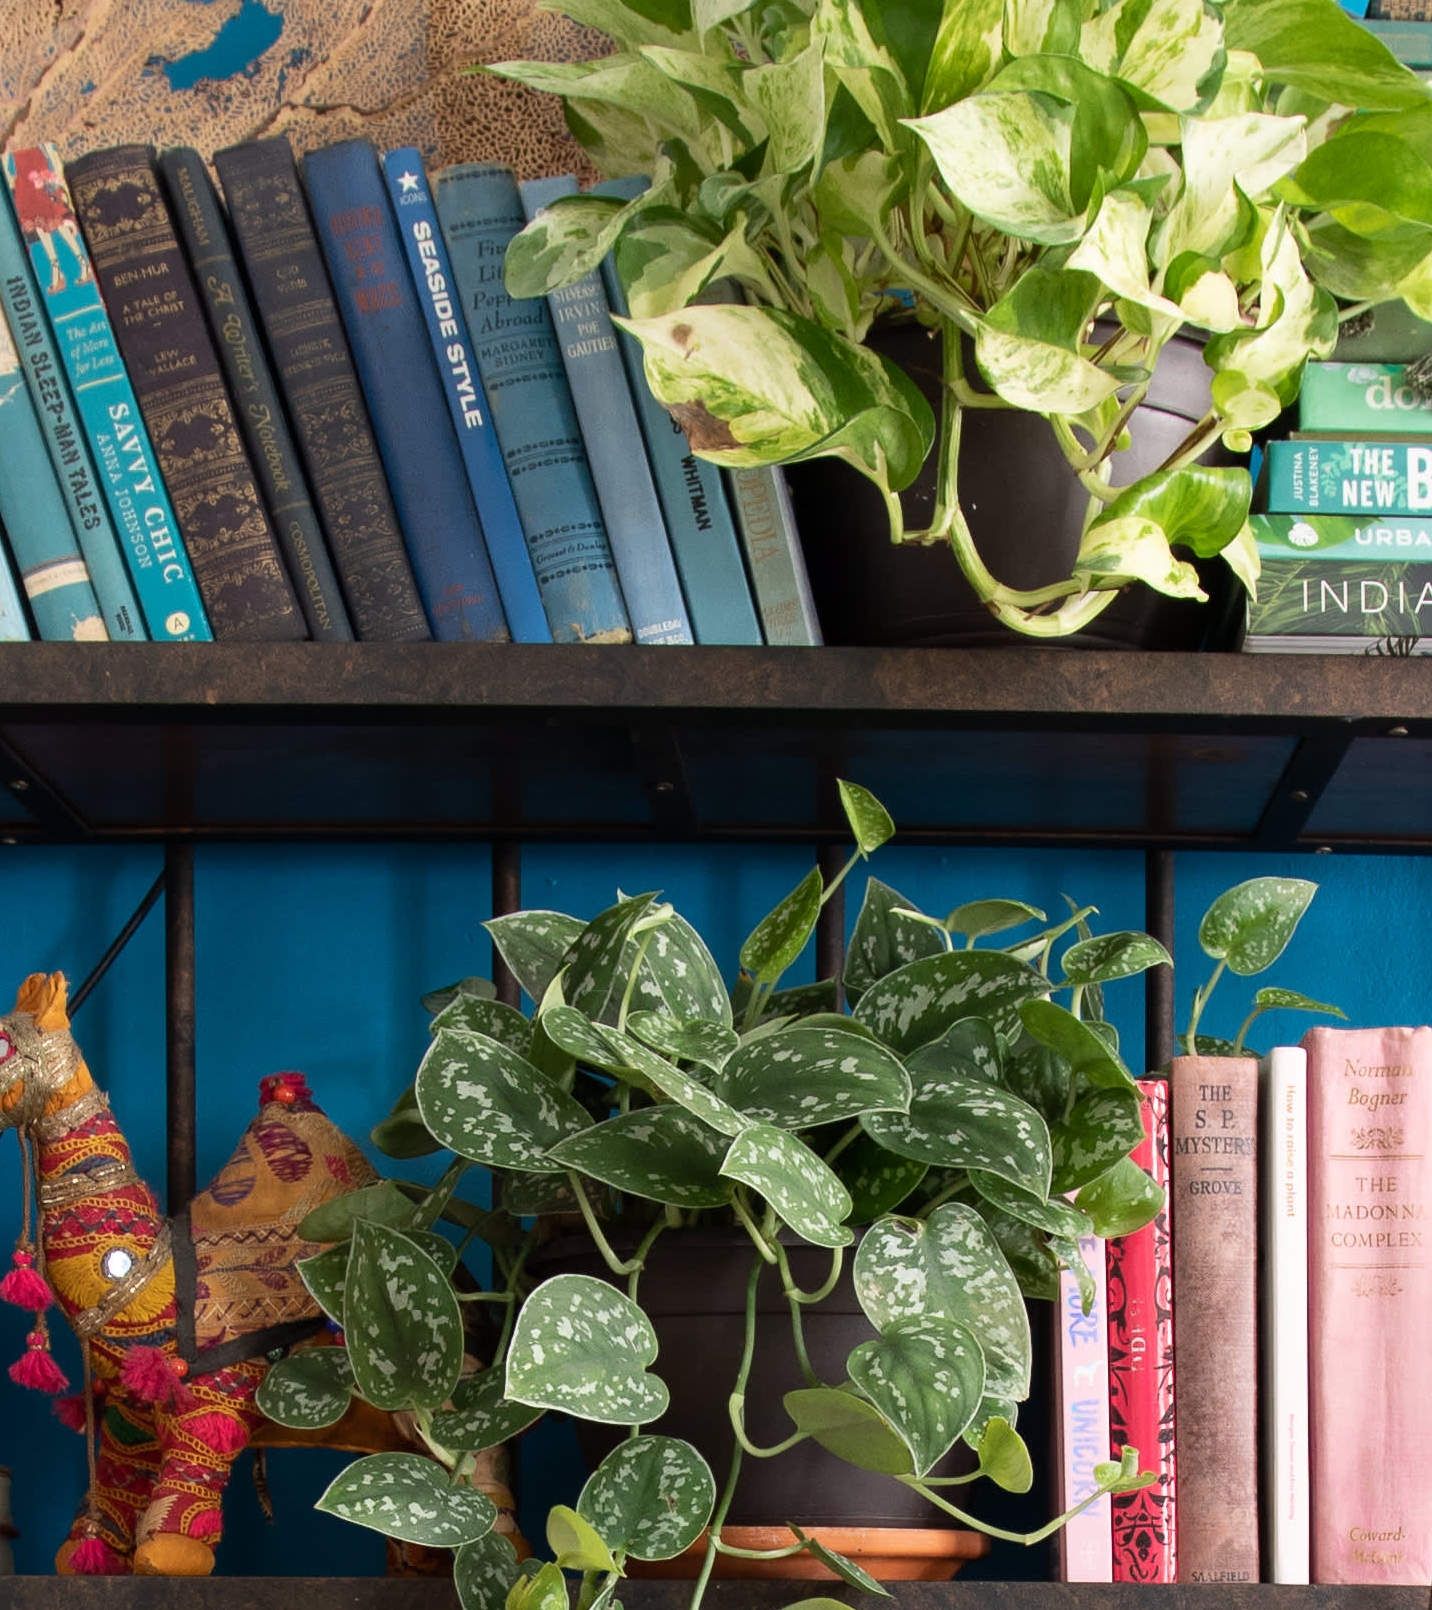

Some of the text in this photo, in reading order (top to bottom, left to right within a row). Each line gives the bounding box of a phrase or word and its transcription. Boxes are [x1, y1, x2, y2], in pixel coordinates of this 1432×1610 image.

[413, 220, 484, 429] SEASIDE STYLE
[480, 305, 544, 334] Abroad
[6, 276, 100, 531] INDIAN SLEEP-MAN TALES
[1350, 448, 1395, 476] THE
[1292, 452, 1304, 501] JUSTINA
[1308, 446, 1320, 507] BLAKENEY
[96, 433, 123, 484] ANNA
[114, 489, 153, 569] JOHNSON
[108, 402, 185, 584] SAVVY CHIC
[680, 454, 712, 532] WHITMAN
[1342, 480, 1396, 508] NEW
[288, 521, 334, 632] COSMOPOLITAN
[1343, 1057, 1415, 1080] Norman
[1199, 1084, 1232, 1102] THE
[1347, 1086, 1407, 1113] Bogner
[1175, 1135, 1258, 1156] MYSTERY
[1189, 1180, 1243, 1196] GROVE
[1355, 1176, 1398, 1193] THE
[1327, 1203, 1428, 1221] MADONNA
[1329, 1230, 1424, 1250] COMPLEX
